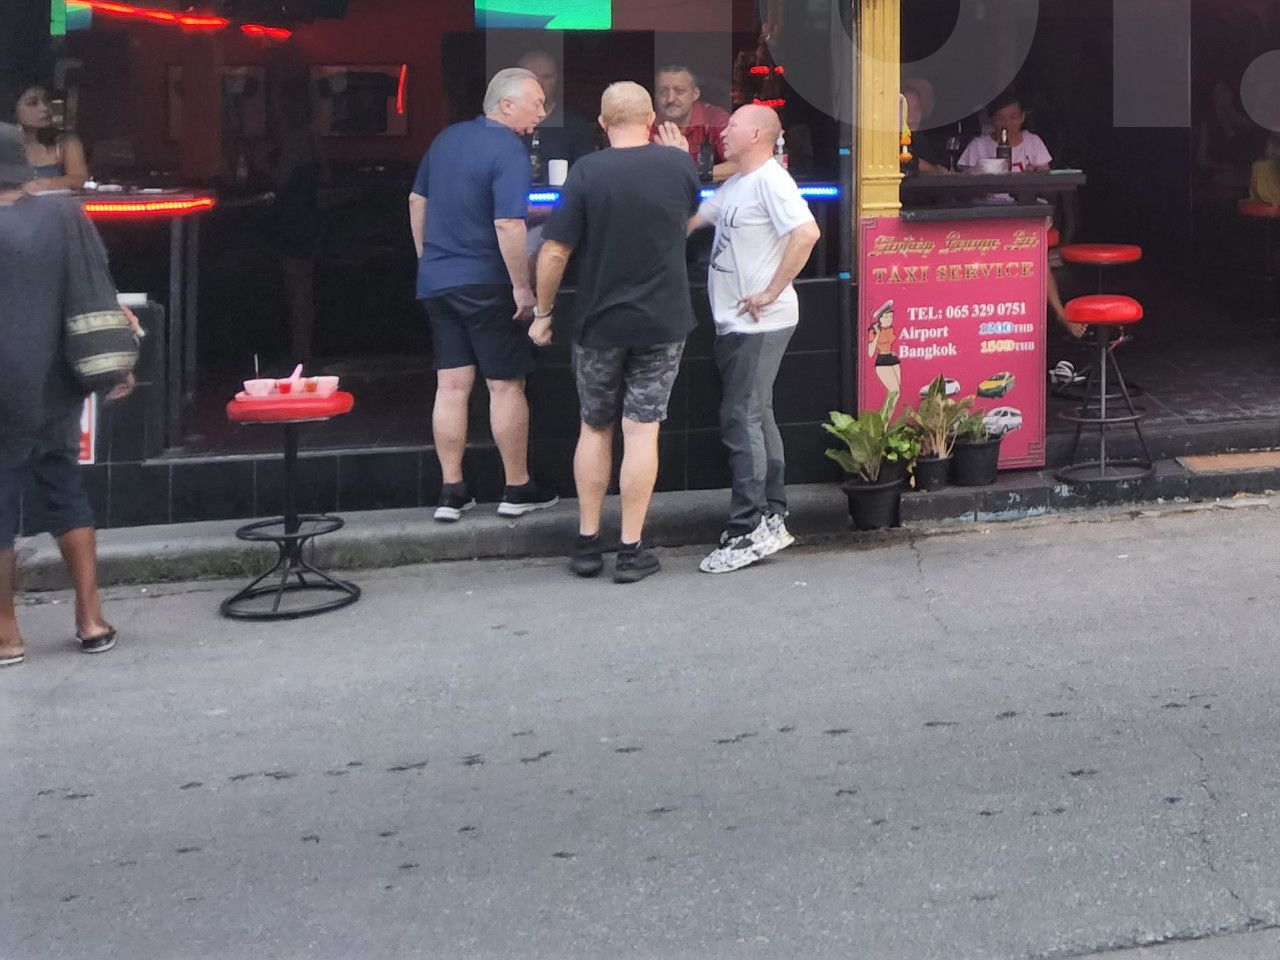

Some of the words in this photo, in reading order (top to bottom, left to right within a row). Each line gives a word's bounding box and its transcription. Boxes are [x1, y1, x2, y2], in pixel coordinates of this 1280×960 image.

[873, 266, 929, 285] TAXI
[936, 261, 1035, 282] SERVICE
[907, 307, 943, 321] TEL:
[946, 305, 969, 319] 065
[971, 303, 996, 318] 329
[997, 302, 1027, 316] 0751
[899, 326, 949, 342] Airport
[899, 343, 957, 360] Bangkok
